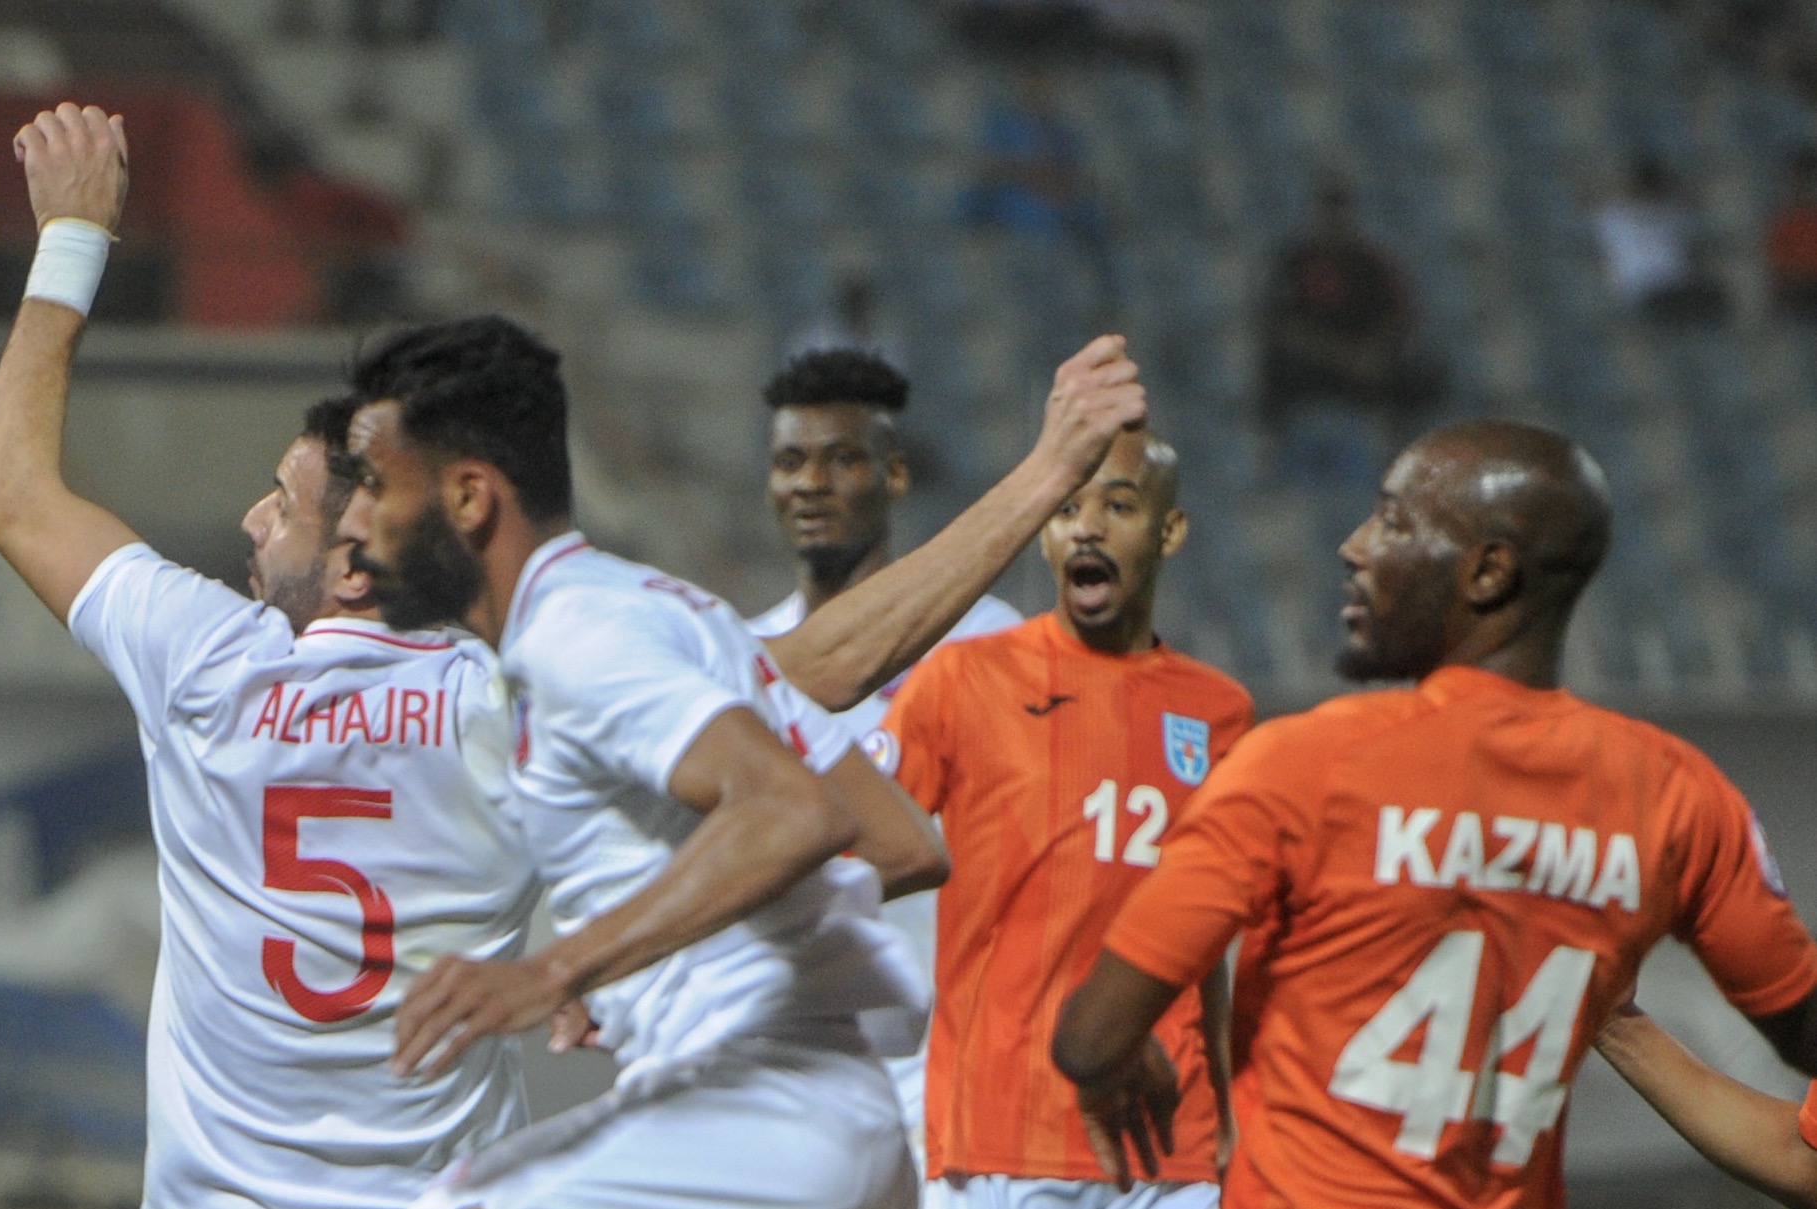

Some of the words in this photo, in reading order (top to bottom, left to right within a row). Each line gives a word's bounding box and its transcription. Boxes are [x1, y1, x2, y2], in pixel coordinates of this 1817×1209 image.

[251, 682, 446, 747] ALHAJRI
[1083, 778, 1169, 868] 12
[1373, 805, 1641, 913] KAZMA
[261, 785, 395, 1023] 5
[1328, 929, 1597, 1168] 44
